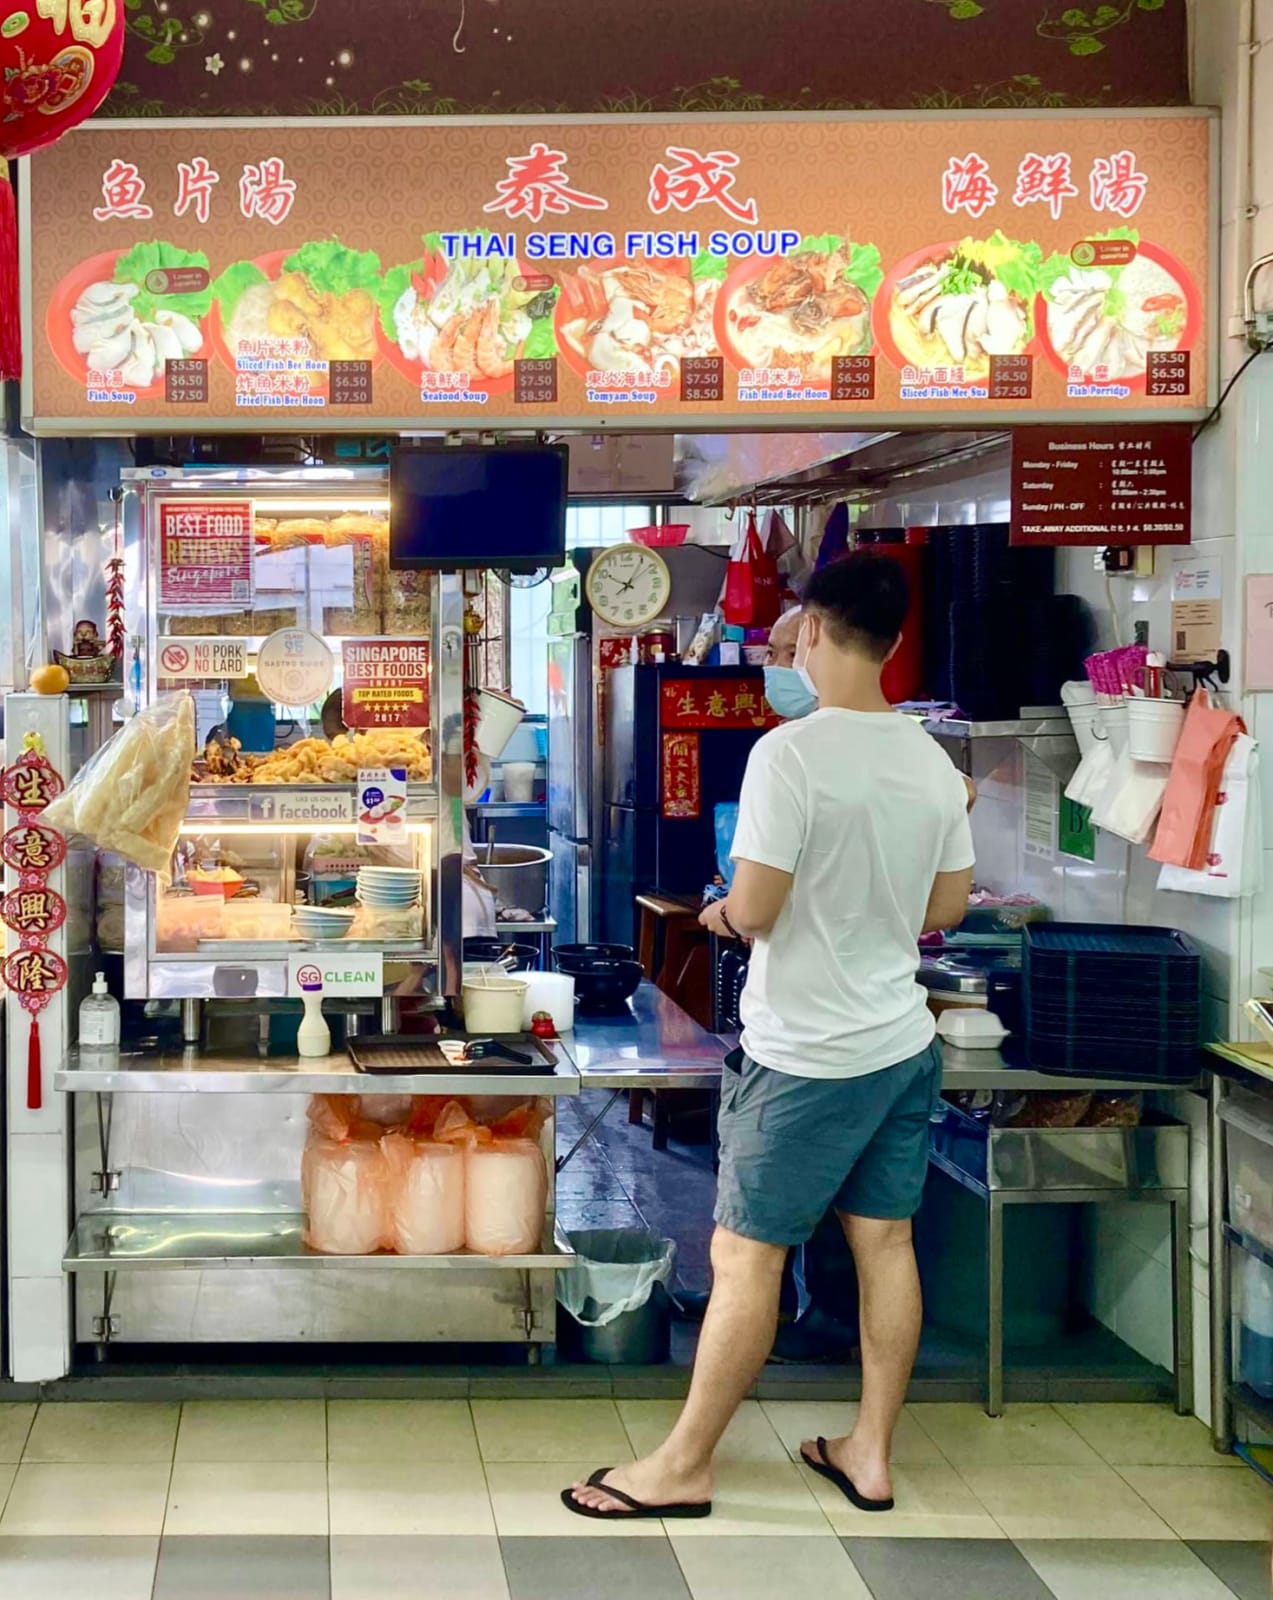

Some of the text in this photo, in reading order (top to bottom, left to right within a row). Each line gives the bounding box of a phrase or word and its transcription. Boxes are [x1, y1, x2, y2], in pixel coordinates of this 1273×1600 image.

[93, 157, 297, 225] 魚片湯
[941, 151, 1149, 220] 海鮮湯
[441, 231, 800, 257] THAI SENG FISH SOUP
[837, 358, 870, 368] $5.50
[994, 356, 1027, 367] $5.50
[1152, 353, 1185, 363] $5.50
[170, 360, 203, 371] $5.50
[237, 359, 327, 370] Sliced Fish Bee Hoon
[335, 362, 367, 372] $5.50
[520, 360, 553, 371] $6.50
[686, 359, 719, 369] $6.50
[837, 373, 870, 384] $6.50
[994, 371, 1027, 382] $6.50
[1152, 368, 1185, 379] $6.50
[170, 375, 203, 386] $6.50
[335, 377, 367, 388] $6.50
[520, 375, 553, 386] $7.50
[686, 374, 719, 385] $7.50
[740, 389, 828, 399] Fish Head Bee Hoon
[837, 388, 870, 398] $7.50
[901, 387, 987, 398] Sliced Fish Mee Sua
[994, 386, 1027, 397] $7.50
[1069, 386, 1129, 398] Fish Porridge
[1152, 383, 1185, 394] $7.50
[88, 390, 135, 402] Fish Soup
[170, 390, 203, 401] $7.50
[237, 395, 324, 405] Fried Fish Bee Hoon
[335, 392, 367, 402] $7.50
[422, 391, 487, 402] Seafood Soup
[520, 390, 553, 401] $8.50
[588, 391, 656, 402] Tomyam Soup
[686, 389, 719, 400] $8.50
[1088, 441, 1115, 451] Hours
[1056, 460, 1079, 470] Friday
[1069, 502, 1085, 510] OFF
[166, 514, 243, 537] BEST FOOD
[1022, 525, 1065, 533] TAKE-AWAY
[1065, 524, 1110, 533] ADDITIONAL
[166, 539, 243, 566] REVIEWS
[167, 565, 241, 588] Singapore
[610, 606, 619, 617] 7
[194, 644, 243, 658] NO PORK
[346, 646, 427, 662] SINGAPORE
[194, 659, 242, 673] NO LARD
[347, 663, 424, 677] BEST FOODS
[357, 690, 414, 698] TOP RATED FOODS
[374, 713, 401, 722] 2017
[280, 804, 348, 819] facebook
[14, 768, 55, 992] 生意興隆
[300, 971, 375, 983] SG CLEAN
